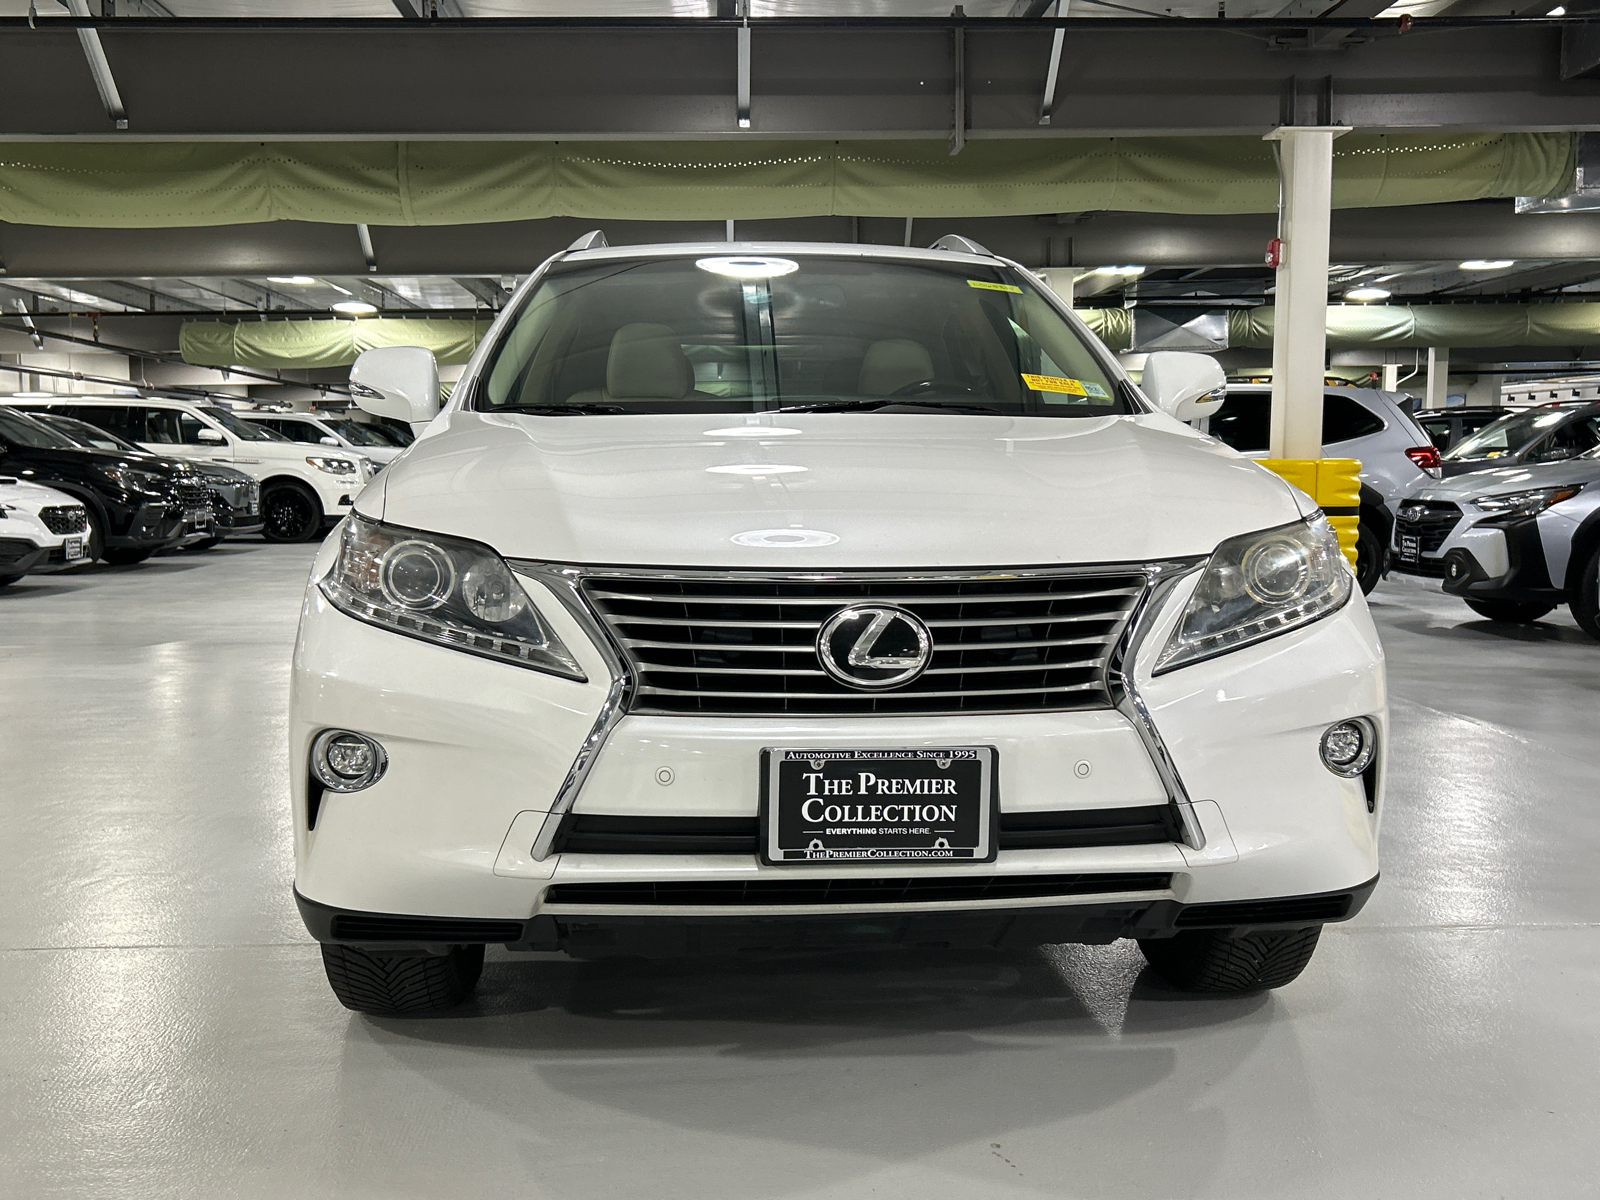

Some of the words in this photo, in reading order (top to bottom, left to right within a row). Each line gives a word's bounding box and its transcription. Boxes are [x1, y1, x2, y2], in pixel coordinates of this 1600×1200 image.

[787, 751, 851, 759] AUTOMOTIVE
[853, 750, 914, 759] EXCELLENCE
[916, 750, 946, 758] SINCE
[949, 750, 976, 759] 1995
[802, 772, 854, 795] THE
[857, 772, 958, 795] PREMIER
[801, 798, 958, 823] COLLECTION
